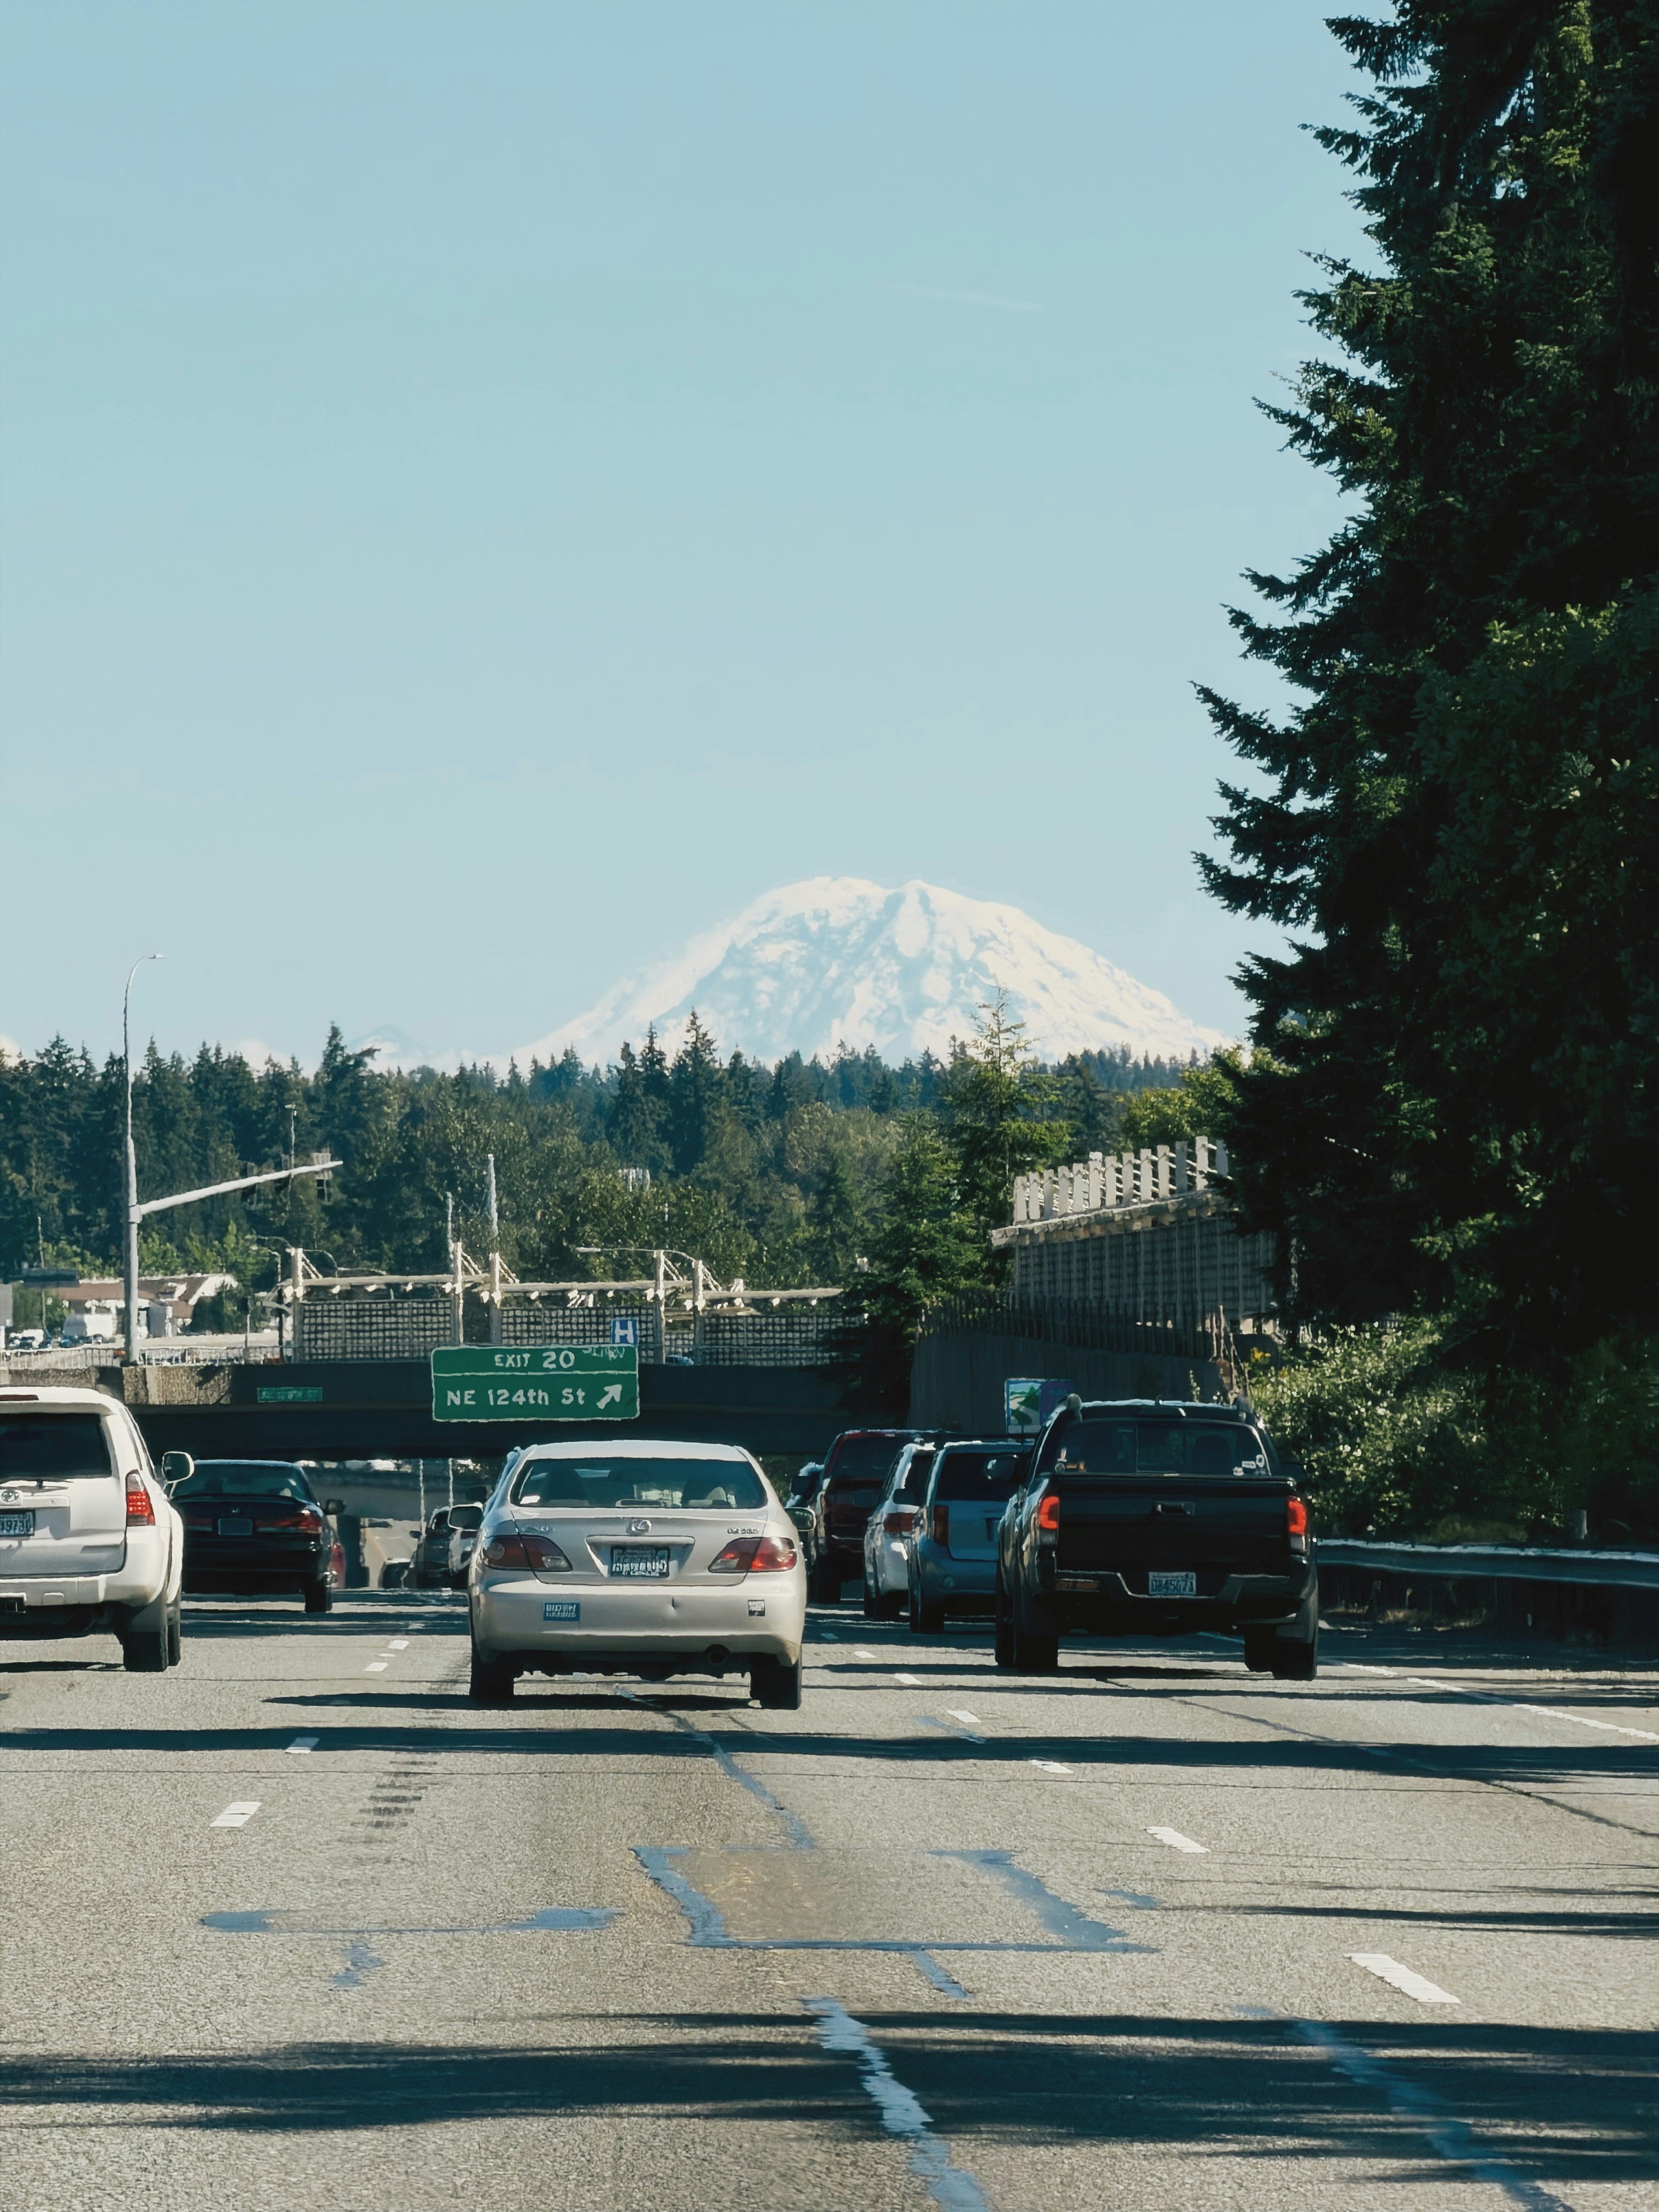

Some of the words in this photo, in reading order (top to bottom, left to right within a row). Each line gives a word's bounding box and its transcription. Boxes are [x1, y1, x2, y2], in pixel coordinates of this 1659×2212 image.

[615, 1321, 634, 1344] H
[494, 1353, 531, 1368] EXIT
[543, 1351, 575, 1369] 20
[447, 1390, 476, 1406] NE
[488, 1389, 549, 1406] 124th
[561, 1388, 585, 1406] St
